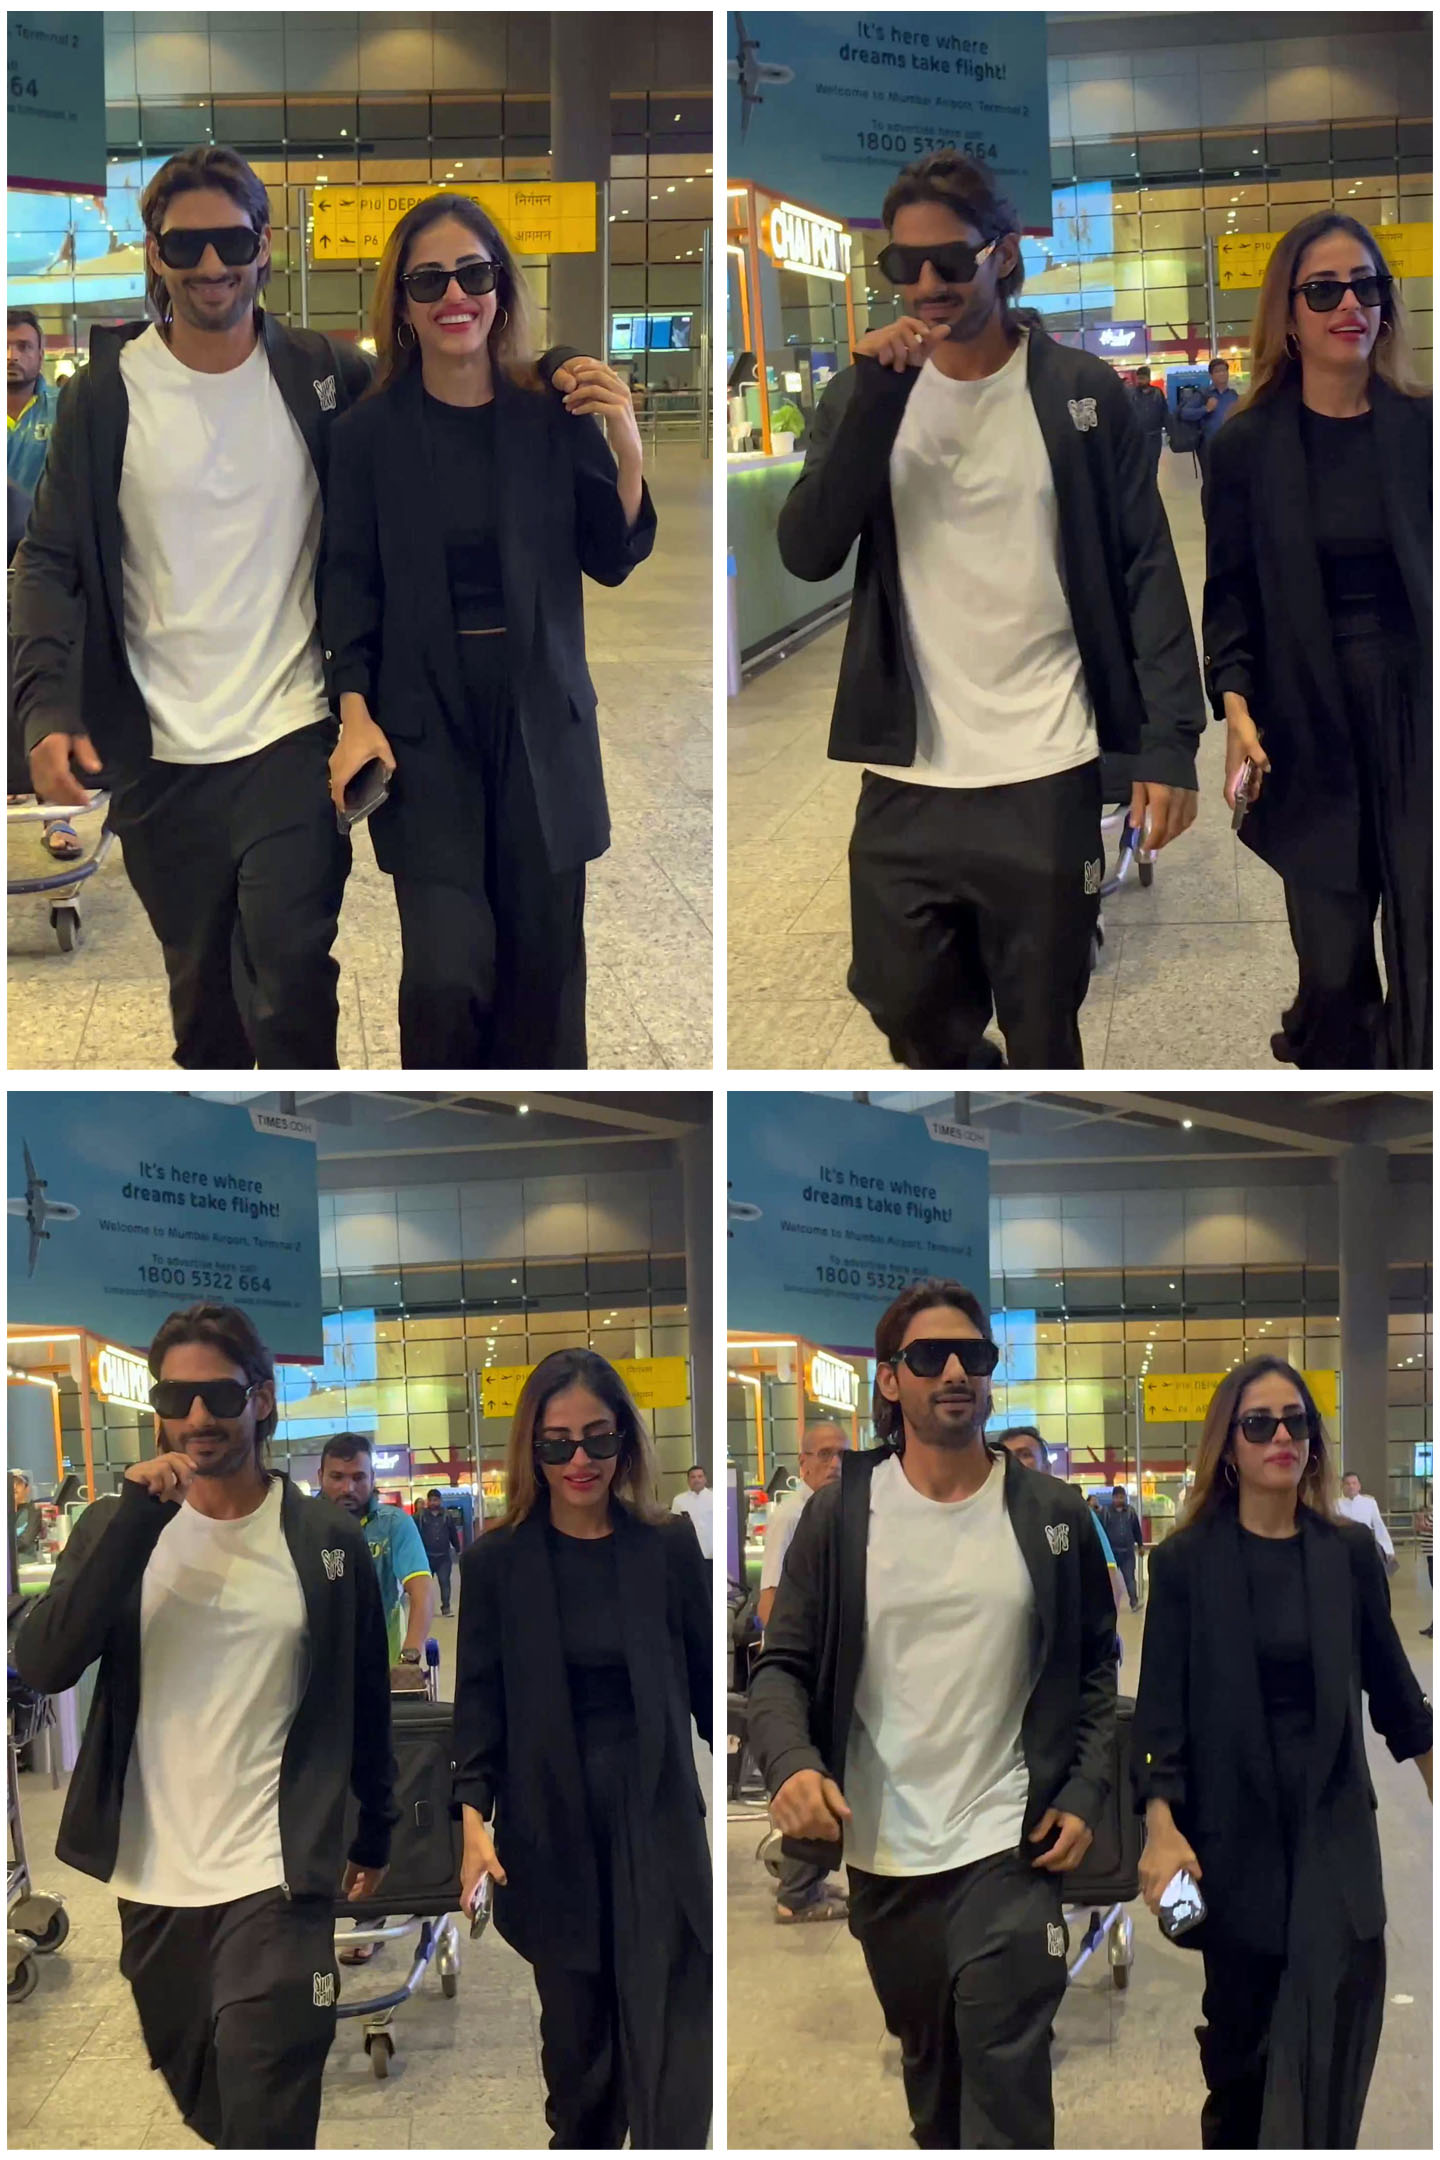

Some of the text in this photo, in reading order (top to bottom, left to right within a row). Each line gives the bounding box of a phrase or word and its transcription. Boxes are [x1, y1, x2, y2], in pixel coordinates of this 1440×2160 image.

[857, 21, 989, 55] It's here where
[839, 43, 1007, 82] dreams take flight!
[816, 83, 869, 99] Welcome
[872, 90, 885, 99] to
[857, 131, 906, 153] 1800
[360, 199, 382, 211] P10
[364, 235, 378, 246] P6
[139, 1160, 263, 1194] It's here where
[820, 1165, 936, 1199] It's here where
[122, 1182, 280, 1219] dreams take flight!
[802, 1186, 952, 1224] dreams take flight!
[99, 1219, 149, 1236] Welcome
[153, 1227, 164, 1237] to
[168, 1227, 209, 1241] Mumbai
[138, 1265, 272, 1292] 1800 5322 664
[816, 1265, 861, 1286] 1800
[867, 1273, 906, 1290] 5322
